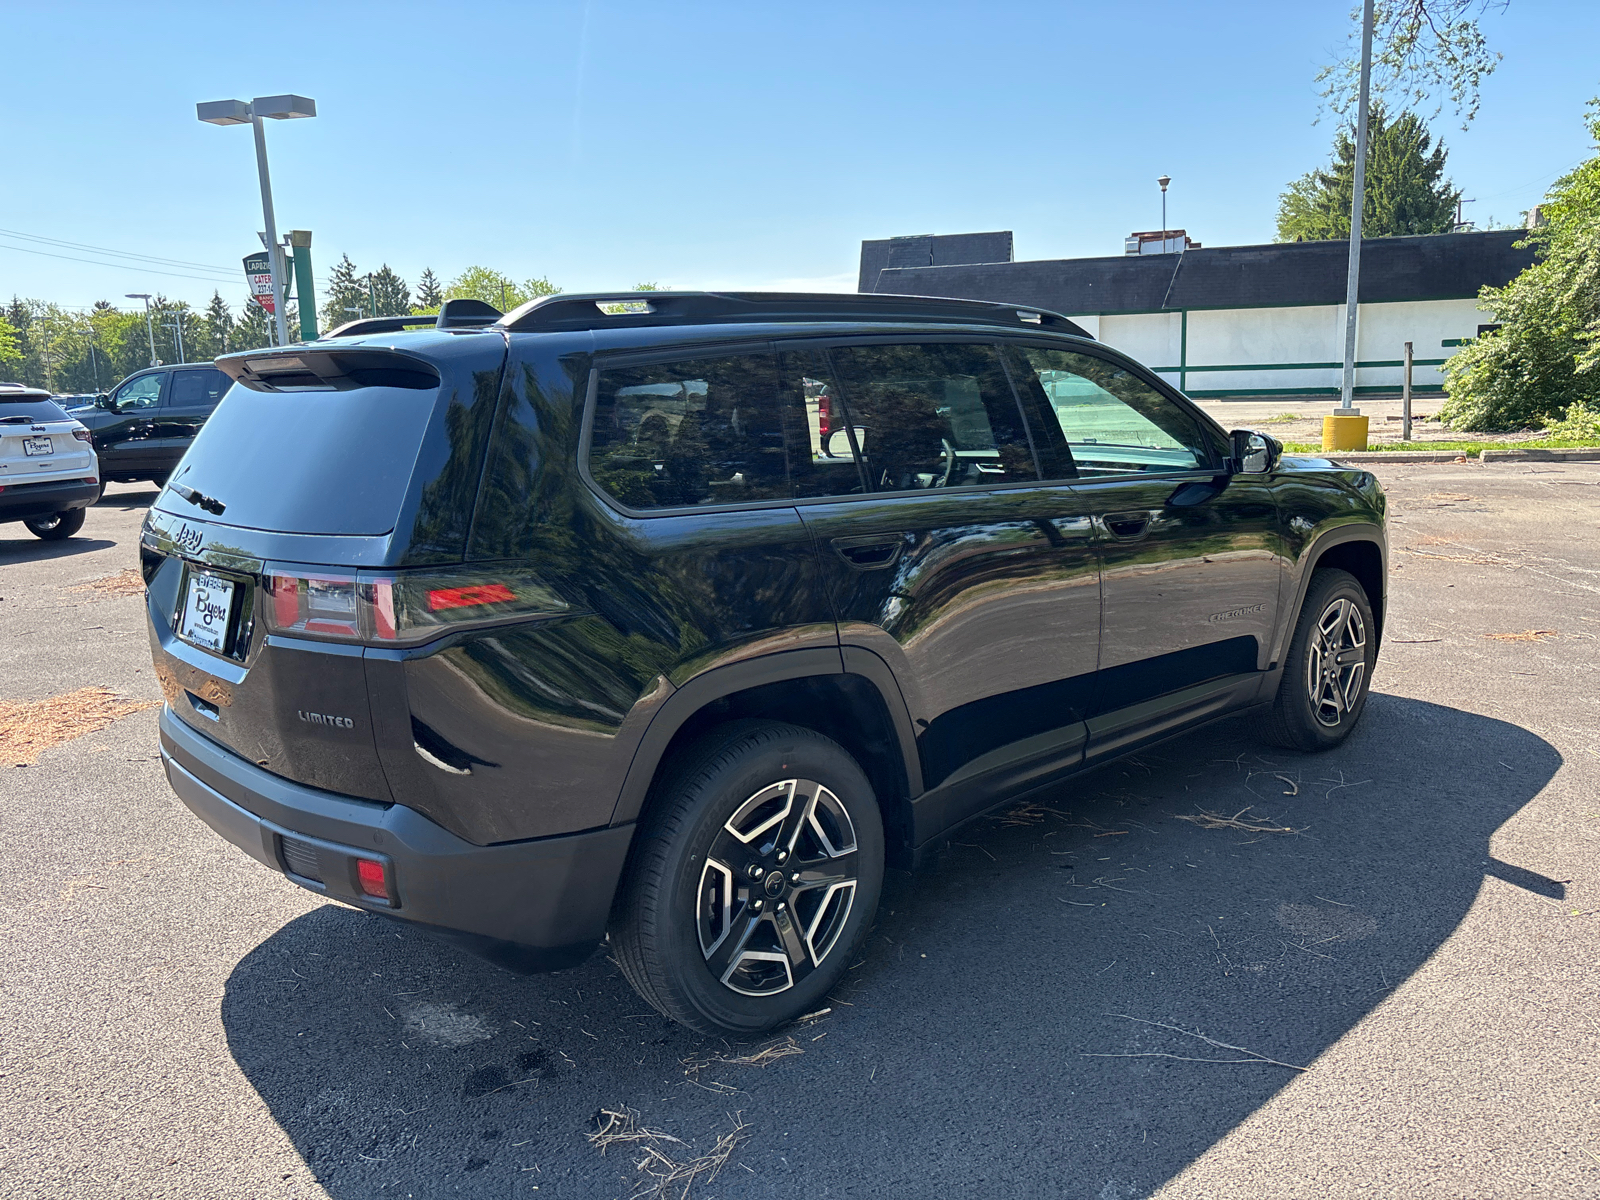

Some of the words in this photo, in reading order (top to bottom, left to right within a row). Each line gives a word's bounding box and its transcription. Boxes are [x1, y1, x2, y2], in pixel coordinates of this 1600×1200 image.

[175, 523, 203, 551] Jeep
[192, 588, 226, 625] Byers
[1209, 603, 1267, 622] CHEROKEE
[298, 710, 354, 729] LIMITED
